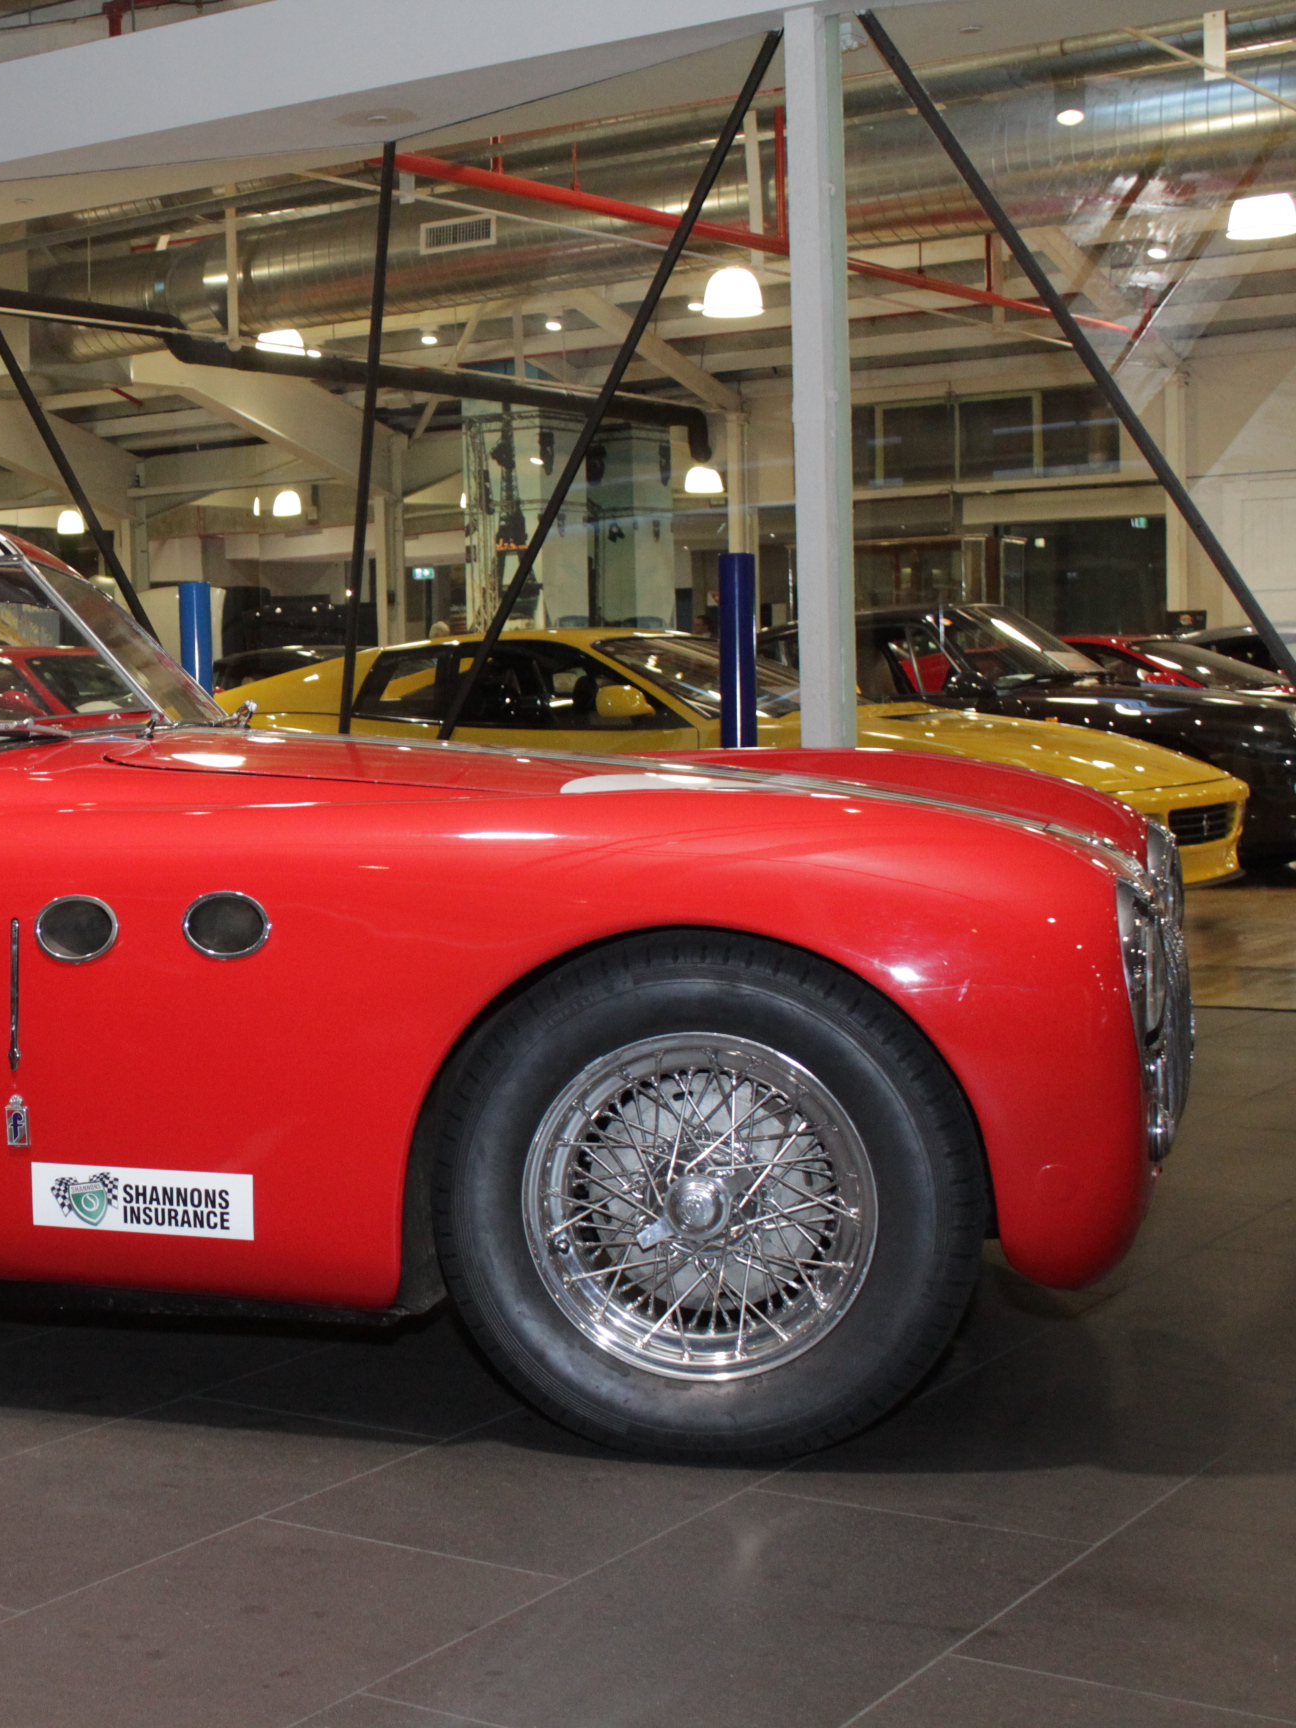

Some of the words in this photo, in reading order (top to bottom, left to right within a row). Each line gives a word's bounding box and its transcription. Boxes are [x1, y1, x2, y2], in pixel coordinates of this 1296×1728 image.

[70, 1184, 102, 1194] SHANNONS
[122, 1184, 230, 1210] SHANNONS
[123, 1205, 230, 1230] INSURANCE
